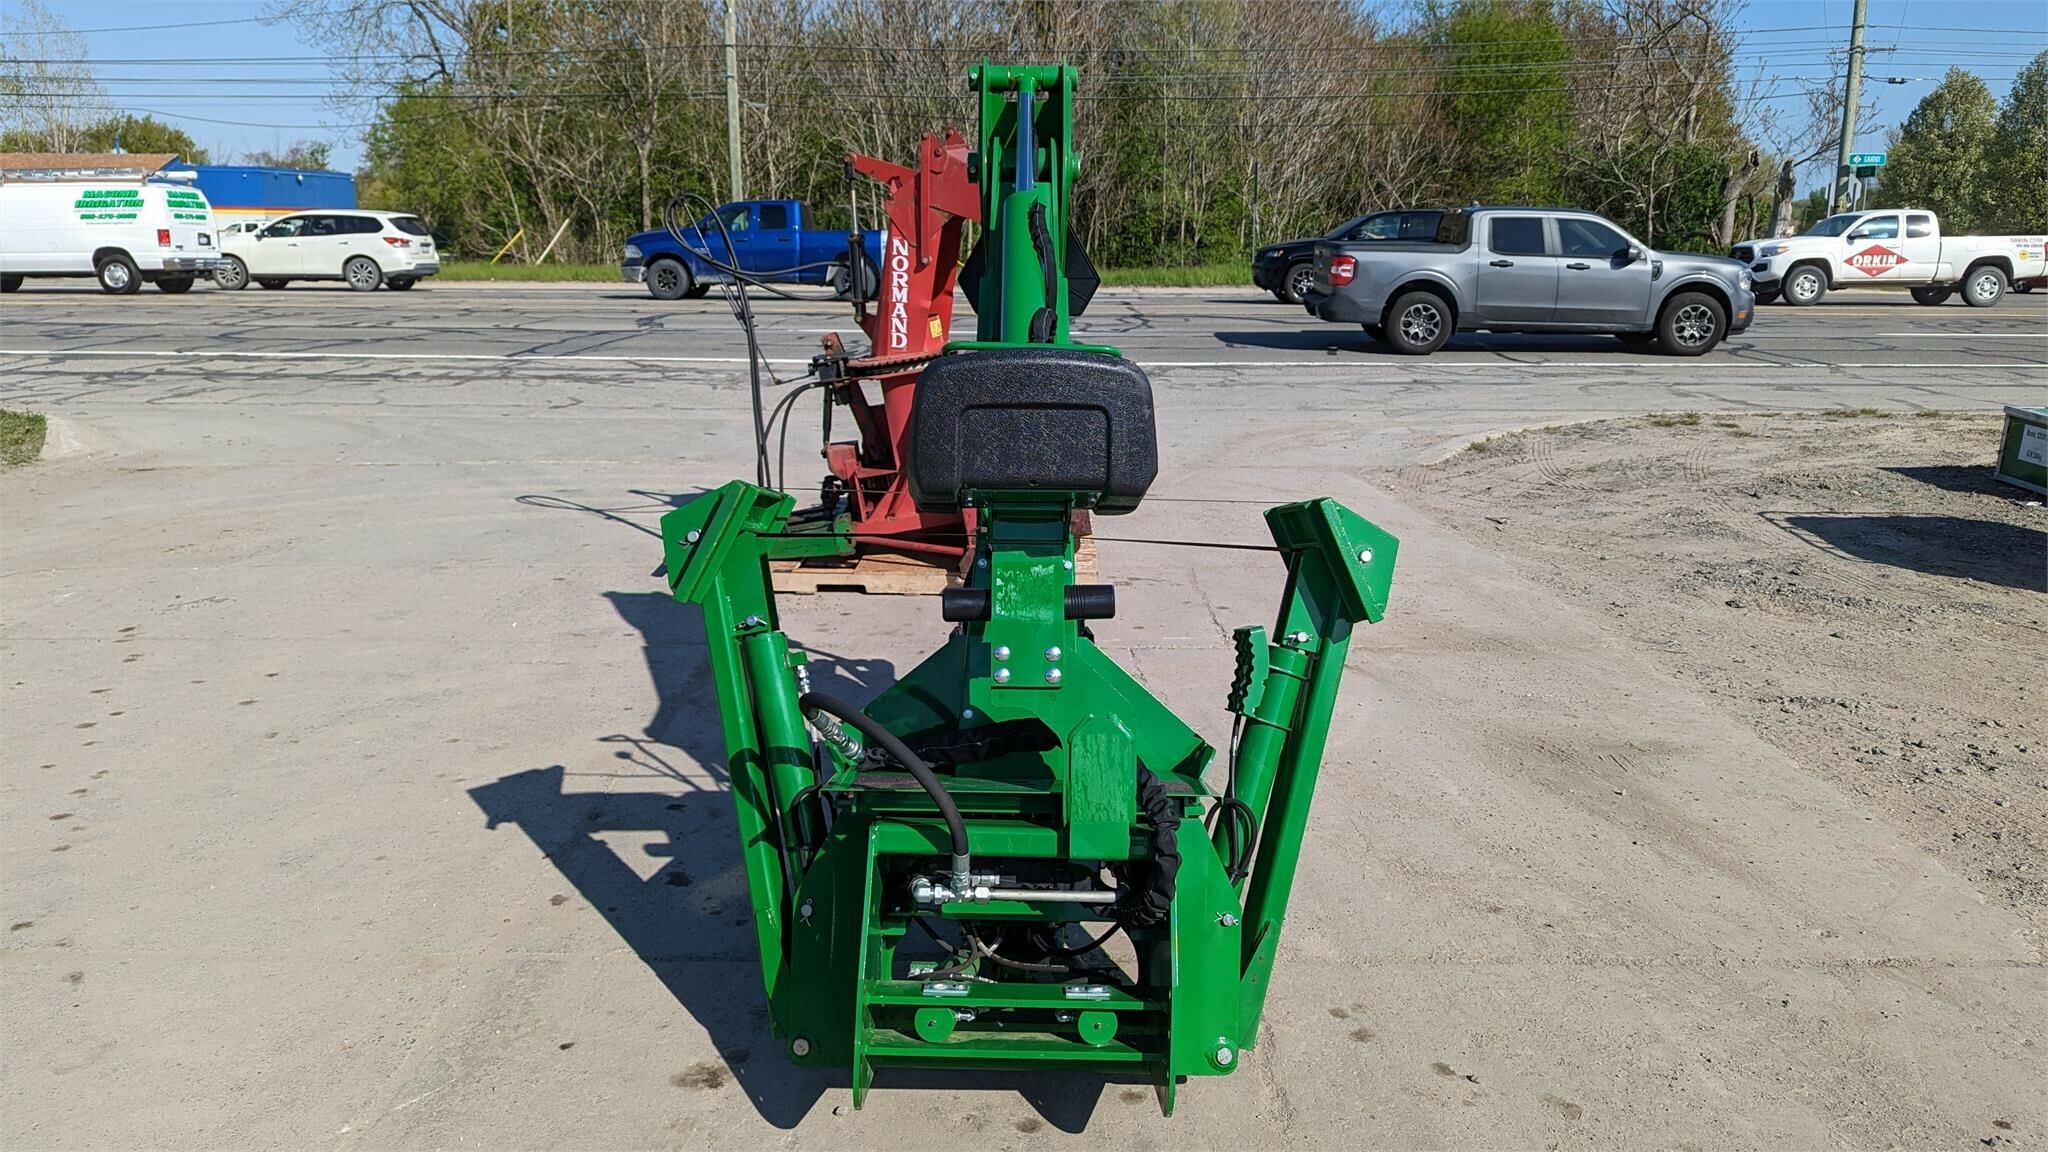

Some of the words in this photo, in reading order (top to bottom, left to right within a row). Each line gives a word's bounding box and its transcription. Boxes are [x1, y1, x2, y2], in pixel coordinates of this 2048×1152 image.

[83, 190, 139, 198] MACOMB
[75, 199, 144, 208] IRRIGATION
[1853, 254, 1897, 267] ORKIN
[890, 238, 909, 348] NORMAND
